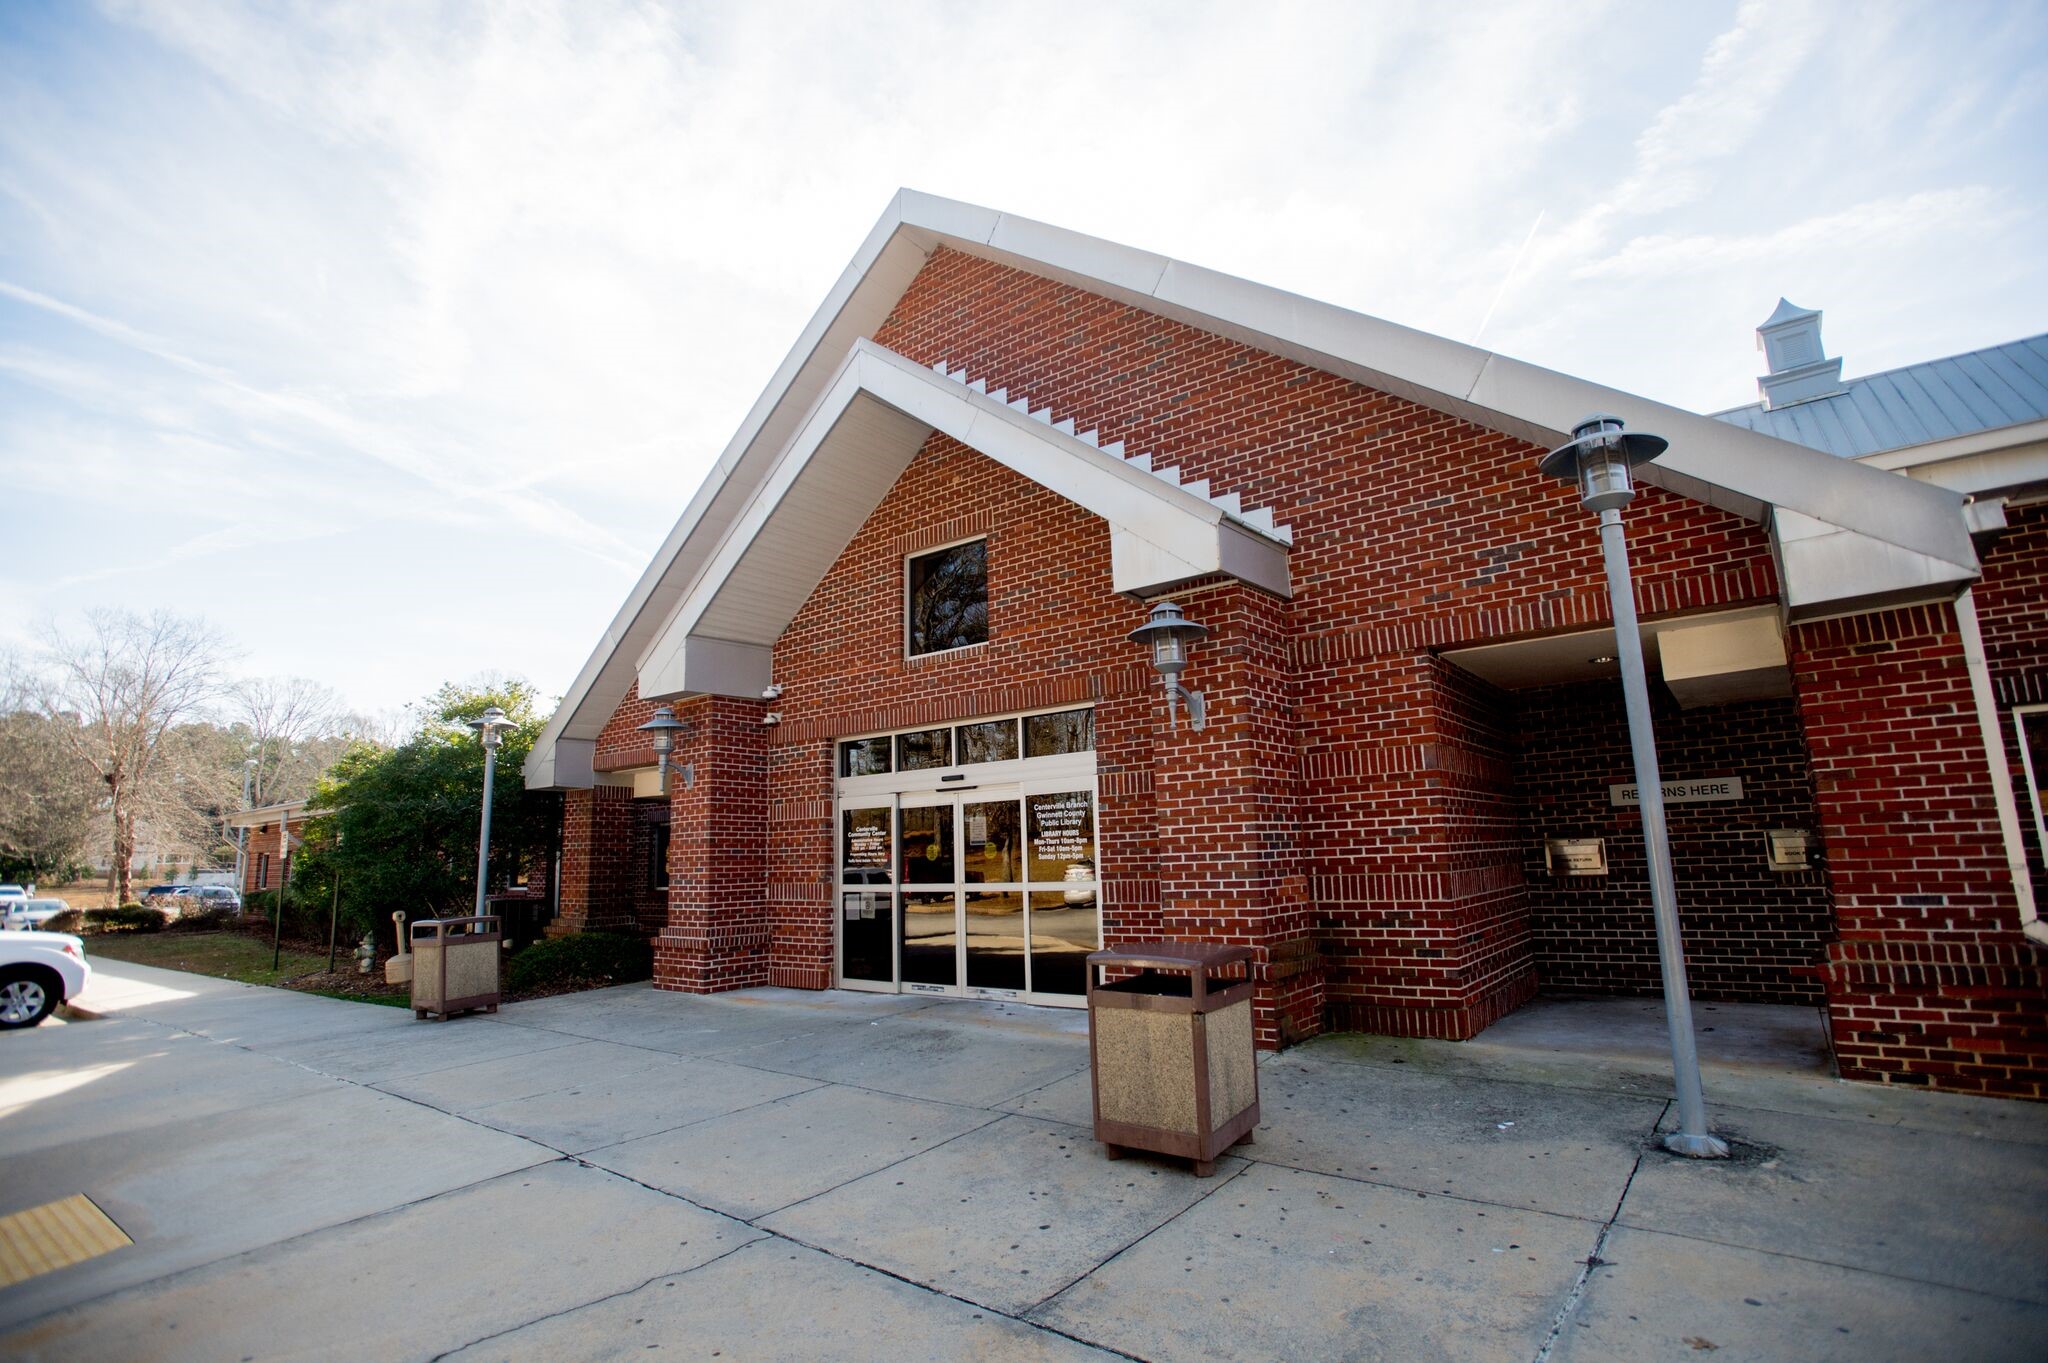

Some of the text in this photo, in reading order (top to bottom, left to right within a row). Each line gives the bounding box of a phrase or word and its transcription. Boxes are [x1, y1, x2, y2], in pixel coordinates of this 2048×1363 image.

[1621, 784, 1730, 800] RERNS HERE
[1060, 818, 1082, 826] Library
